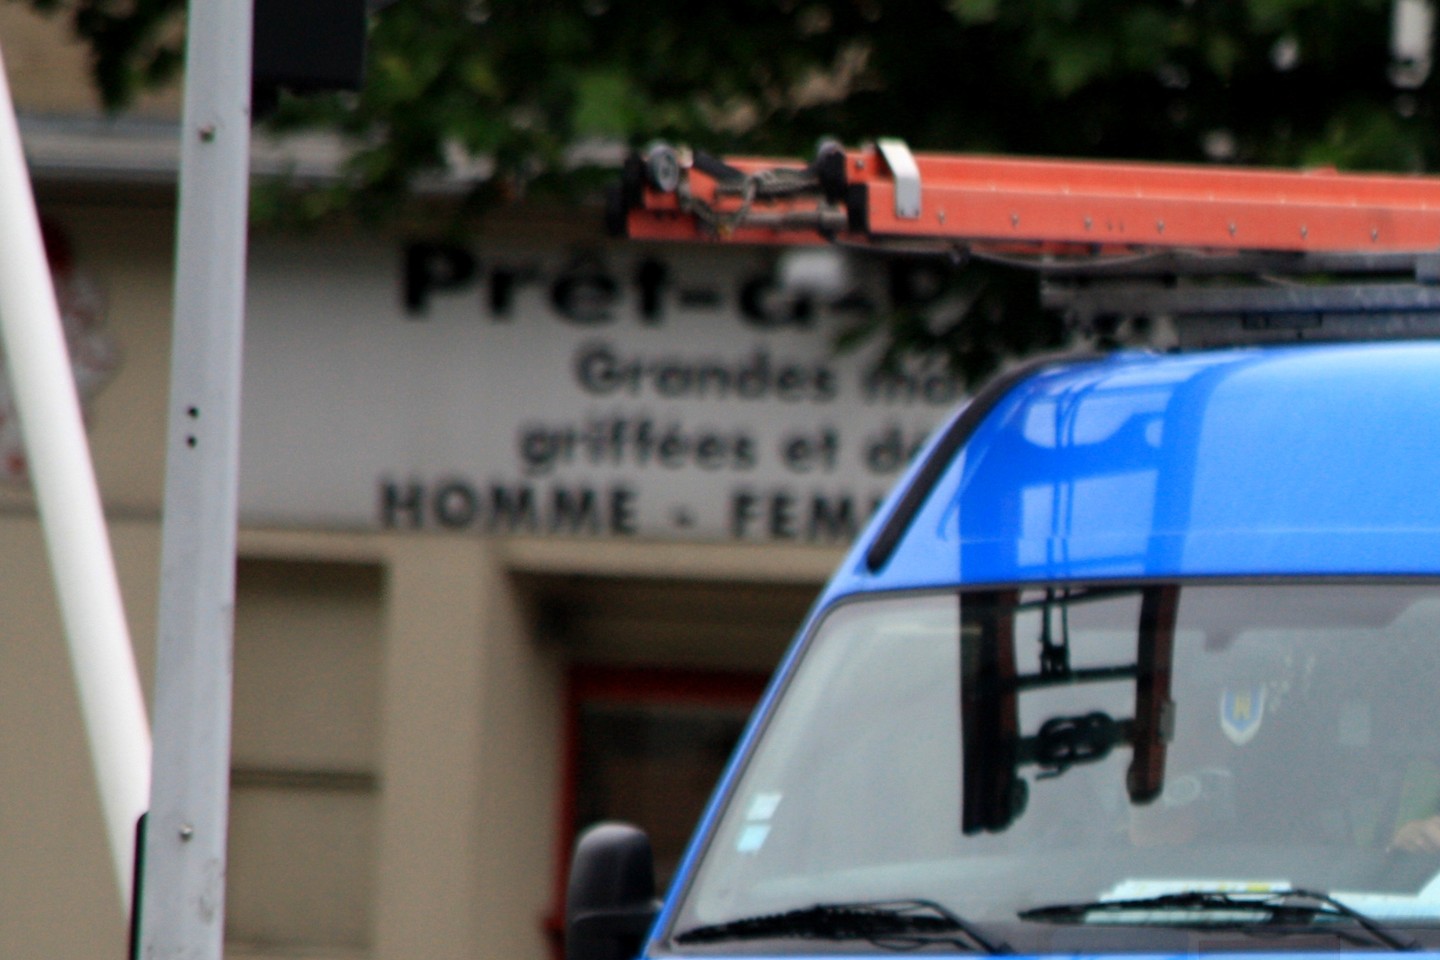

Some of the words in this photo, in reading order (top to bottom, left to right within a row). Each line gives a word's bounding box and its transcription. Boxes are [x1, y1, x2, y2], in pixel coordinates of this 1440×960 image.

[573, 341, 839, 399] Grandes
[520, 417, 757, 476] griffées
[783, 424, 839, 473] et
[379, 479, 639, 536] HOMME
[731, 488, 886, 540] FEM
